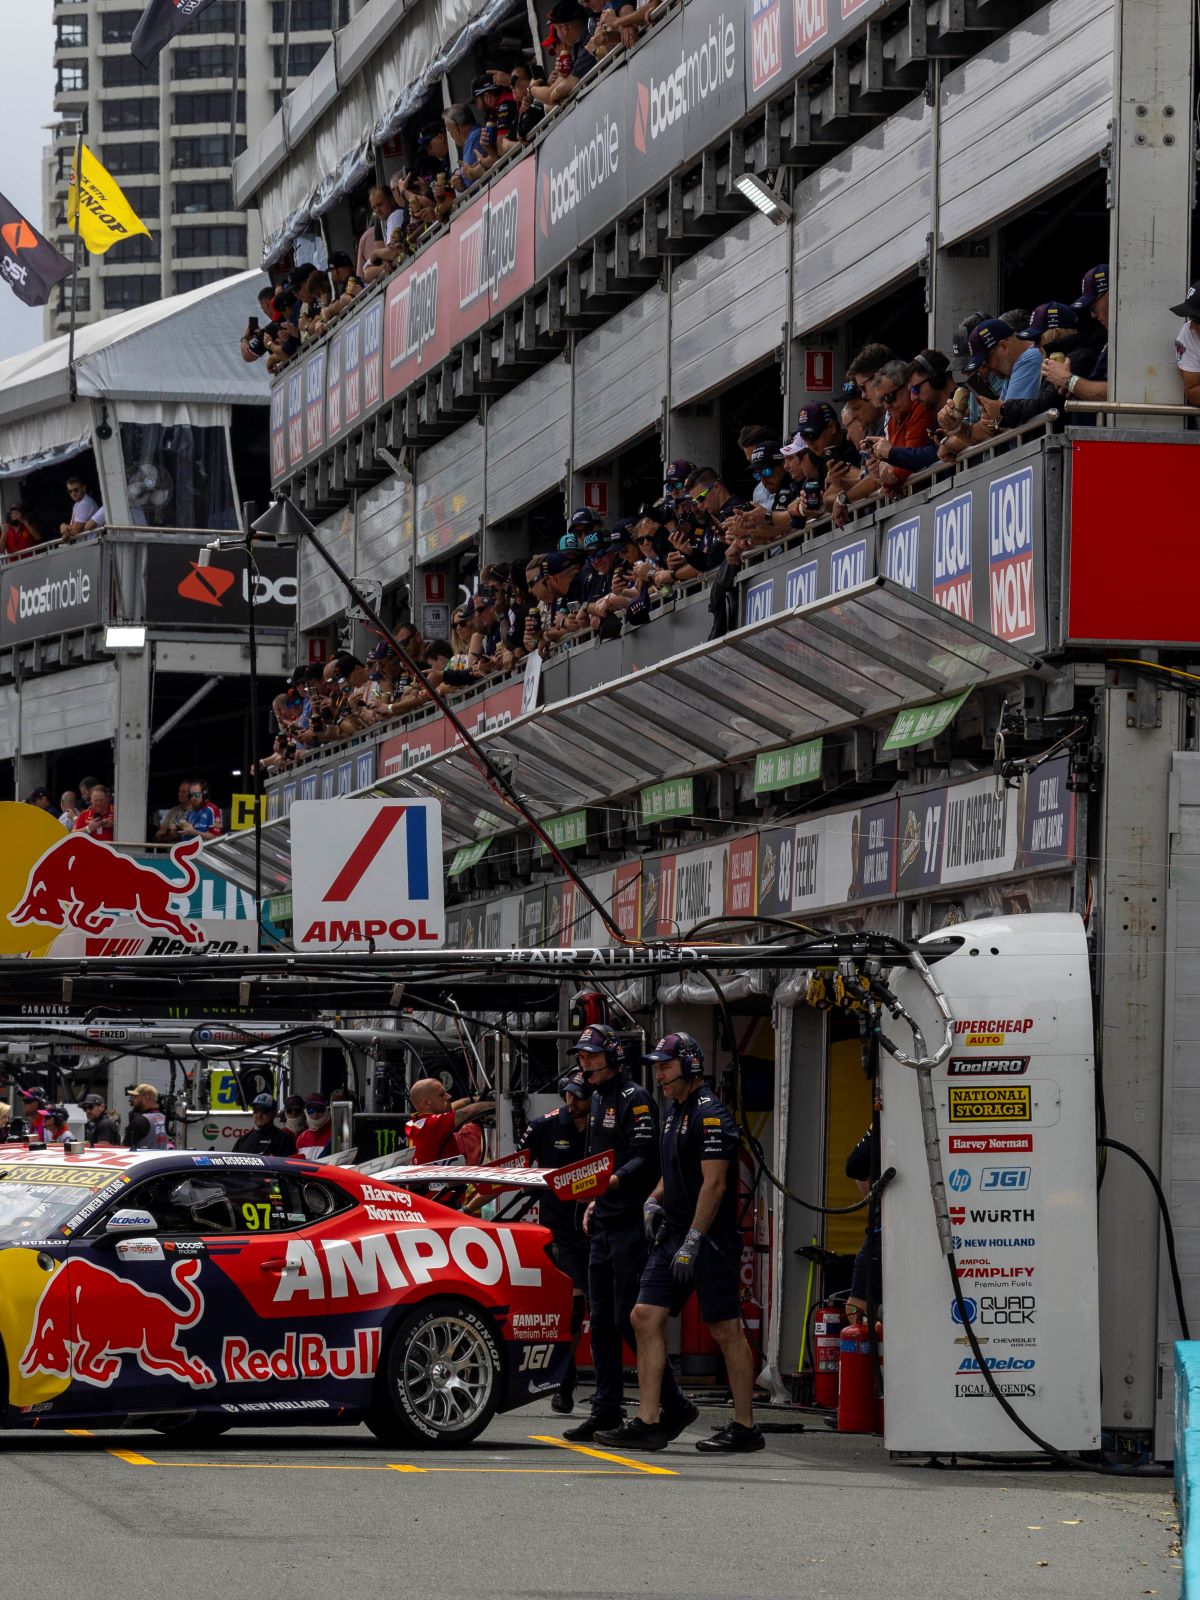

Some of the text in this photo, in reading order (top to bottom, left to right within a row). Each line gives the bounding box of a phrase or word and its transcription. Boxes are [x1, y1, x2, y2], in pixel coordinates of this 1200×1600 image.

[753, 7, 780, 82] MOLY
[79, 188, 128, 234] UNLOP
[990, 477, 1031, 553] LIQUI
[935, 502, 971, 583] LIQUI
[991, 558, 1033, 638] MOLY
[924, 806, 941, 873] 97
[778, 840, 791, 902] 88
[301, 918, 439, 943] AMPOL
[21, 1005, 70, 1015] CARAVANS
[100, 1029, 125, 1039] ENZED
[954, 1019, 1034, 1034] UPERCHEAP
[969, 1036, 1000, 1044] AUTO
[953, 1059, 1022, 1073] ToolPRO
[953, 1090, 1026, 1101] NATIONAL
[956, 1104, 1024, 1116] STORAGE
[953, 1139, 1028, 1150] Harvey Norman
[211, 1156, 265, 1166] van GISBERGEN
[9, 1168, 110, 1185] STORAGE
[553, 1156, 610, 1190] SUPERCHEAP
[953, 1169, 1026, 1191] hp JGI
[575, 1179, 595, 1190] AUTO
[359, 1185, 412, 1207] Harvey
[67, 1180, 125, 1230] SWIM BETWEEN THE FLAGS
[110, 1216, 151, 1225] ACDelco
[241, 1203, 271, 1230] 97
[363, 1204, 426, 1224] Norman
[964, 1238, 1035, 1247] NEW HOLLAND
[272, 1226, 542, 1302] AMPOL
[964, 1267, 1035, 1278] AMPLIFY
[974, 1280, 1009, 1288] Premium
[981, 1296, 1035, 1310] QUAD
[519, 1314, 561, 1326] AMPLIFY
[981, 1311, 1035, 1324] LOCK
[513, 1328, 558, 1339] Premium Fuels
[465, 1313, 500, 1372] DUNLOP
[221, 1332, 297, 1382] Red
[299, 1327, 382, 1381] Bull
[519, 1344, 555, 1372] JGI
[954, 1384, 1036, 1397] LOCAL LGENDS
[239, 1400, 330, 1411] NEW HOLLAND
